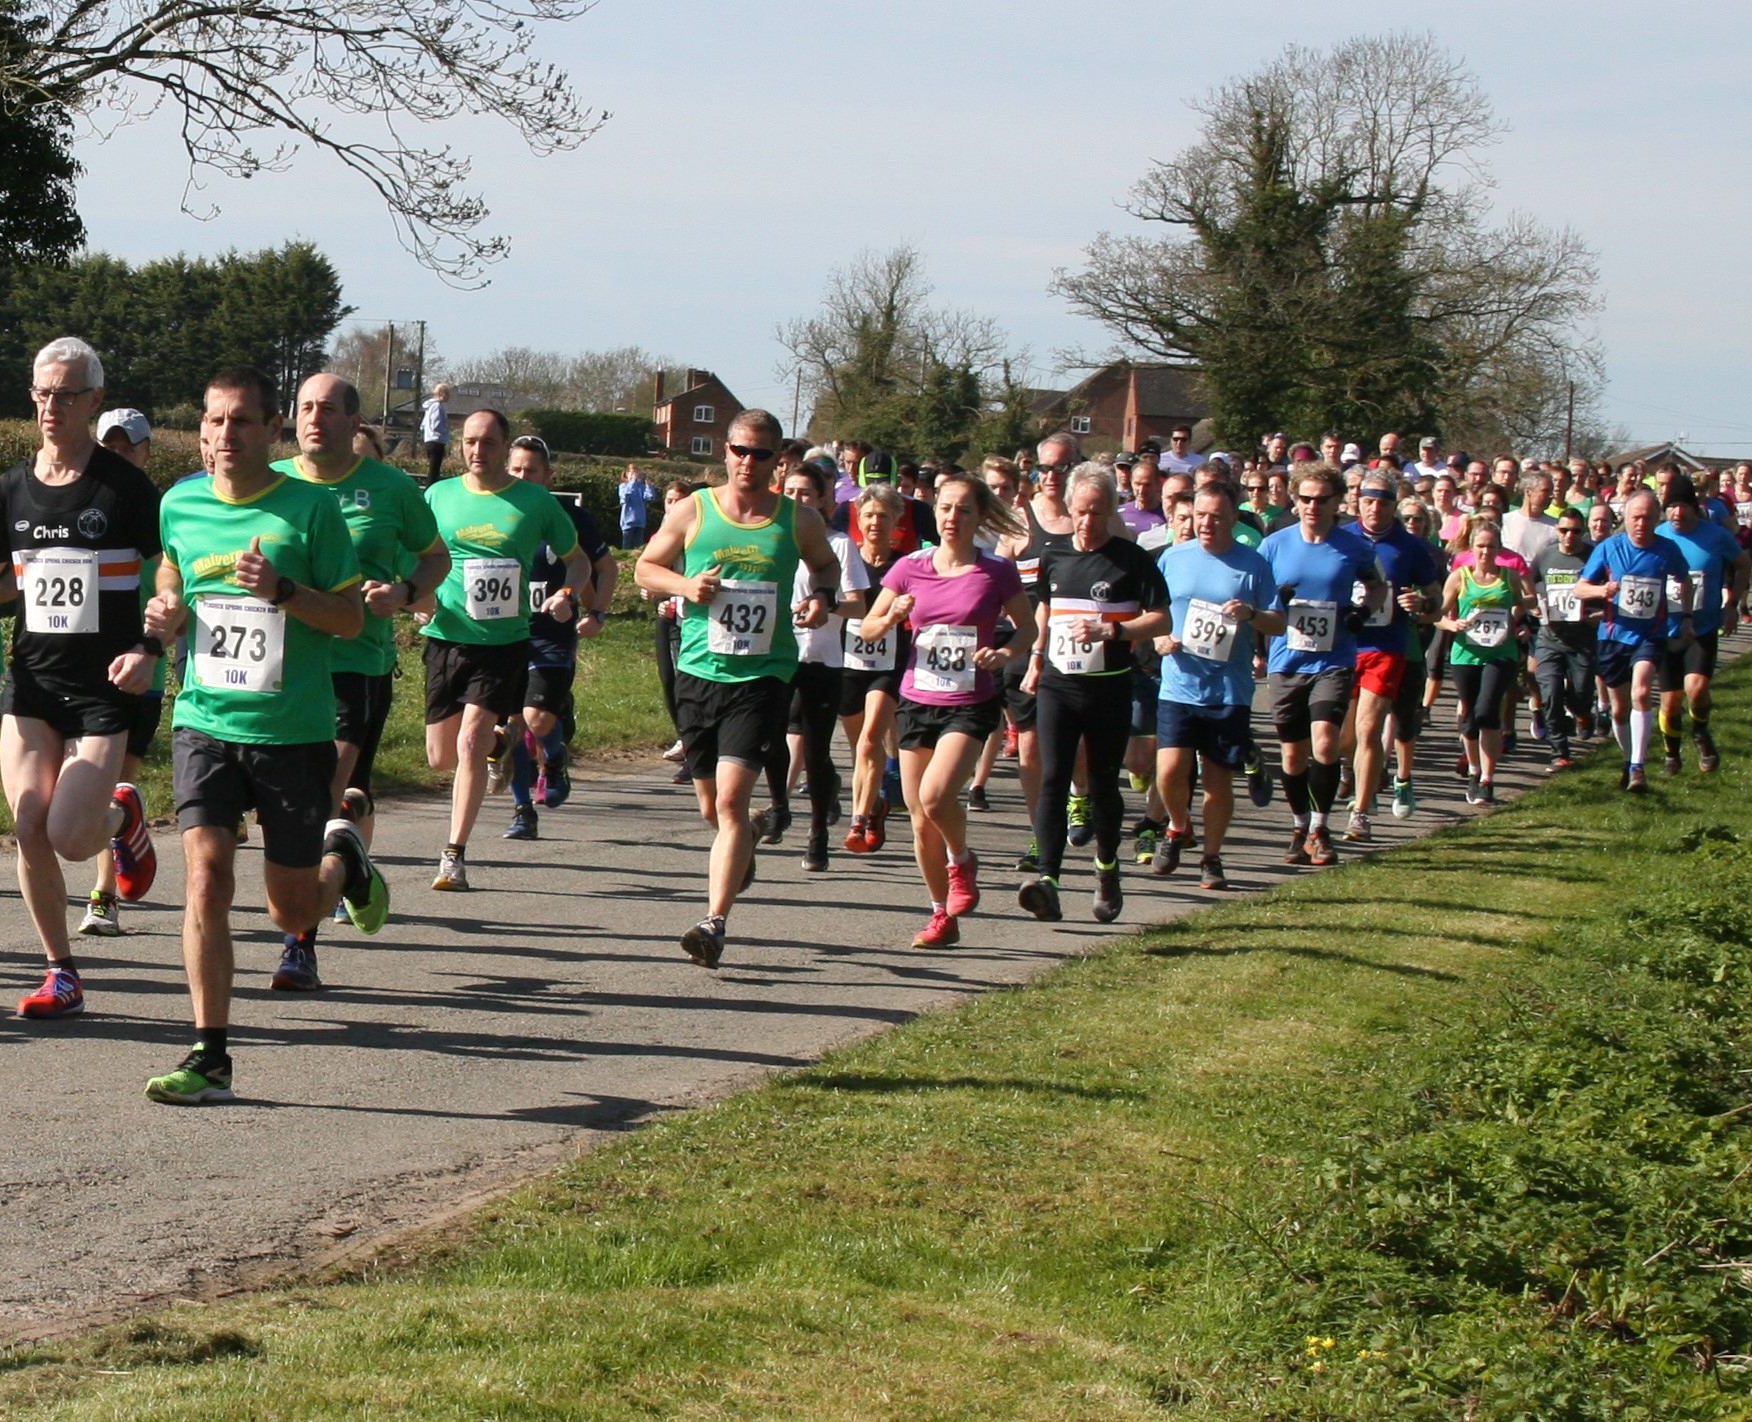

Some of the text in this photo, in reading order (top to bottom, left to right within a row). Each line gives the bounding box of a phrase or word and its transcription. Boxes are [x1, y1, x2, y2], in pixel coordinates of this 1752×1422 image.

[33, 525, 69, 539] Chris
[35, 577, 84, 607] 228
[474, 577, 512, 602] 396
[1626, 589, 1654, 608] 343
[48, 615, 68, 628] 10K
[486, 607, 500, 616] 10K
[719, 603, 767, 634] 432
[1190, 617, 1228, 646] 399
[1295, 615, 1328, 637] 453
[1474, 620, 1500, 635] 267
[210, 625, 266, 662] 273
[854, 636, 887, 656] 284
[926, 646, 966, 672] 438
[1067, 660, 1083, 670] 10K
[225, 669, 248, 685] 10K
